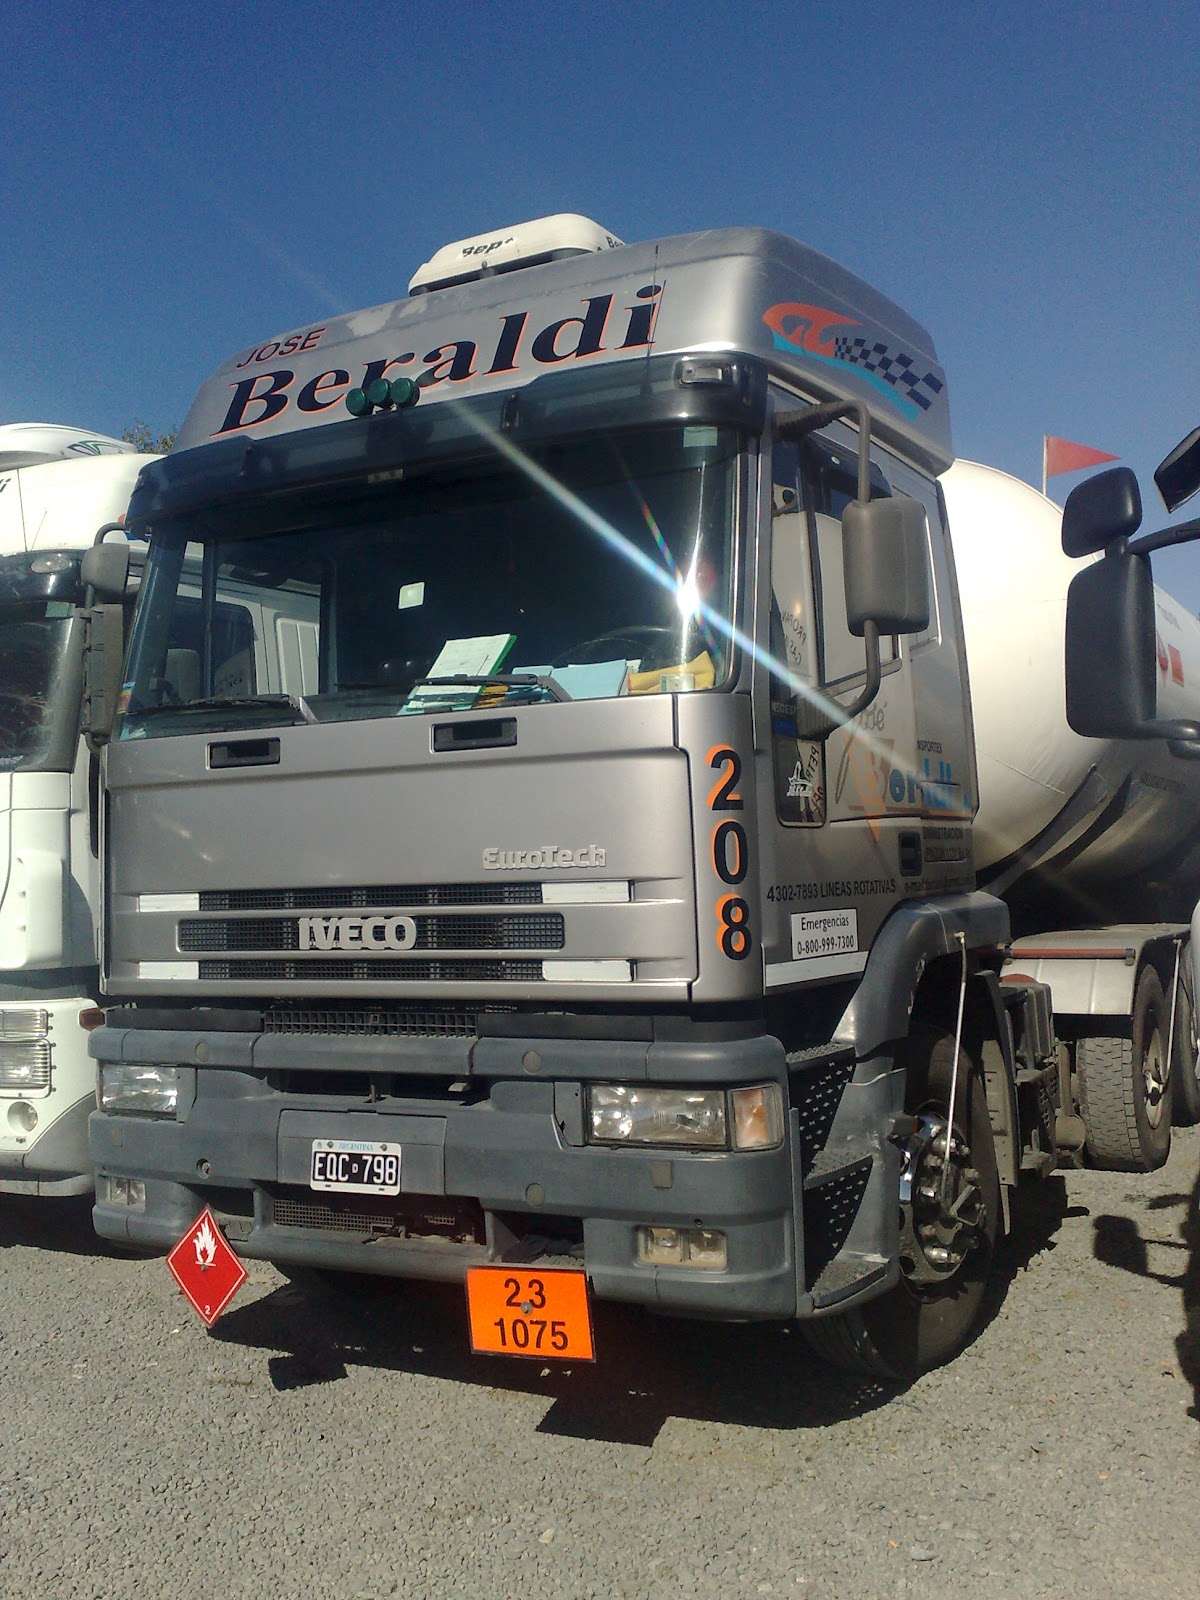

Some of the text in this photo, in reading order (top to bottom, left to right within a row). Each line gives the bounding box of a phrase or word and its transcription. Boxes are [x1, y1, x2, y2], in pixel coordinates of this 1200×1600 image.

[208, 284, 666, 438] Beraldi
[237, 328, 326, 368] JOSE
[484, 845, 606, 870] EuroTech
[705, 743, 752, 961] 208
[767, 879, 896, 903] 4302-7893 LINEAS ROTATIVAS
[298, 916, 417, 950] IVECO
[800, 914, 849, 932] Emergencias
[797, 935, 855, 955] 0-800-999-7300
[338, 1142, 375, 1151] ARGENTINA
[314, 1152, 349, 1181] EQC
[362, 1155, 397, 1184] 798
[504, 1278, 547, 1309] 23
[204, 1305, 211, 1316] 2
[493, 1318, 569, 1351] 1075
